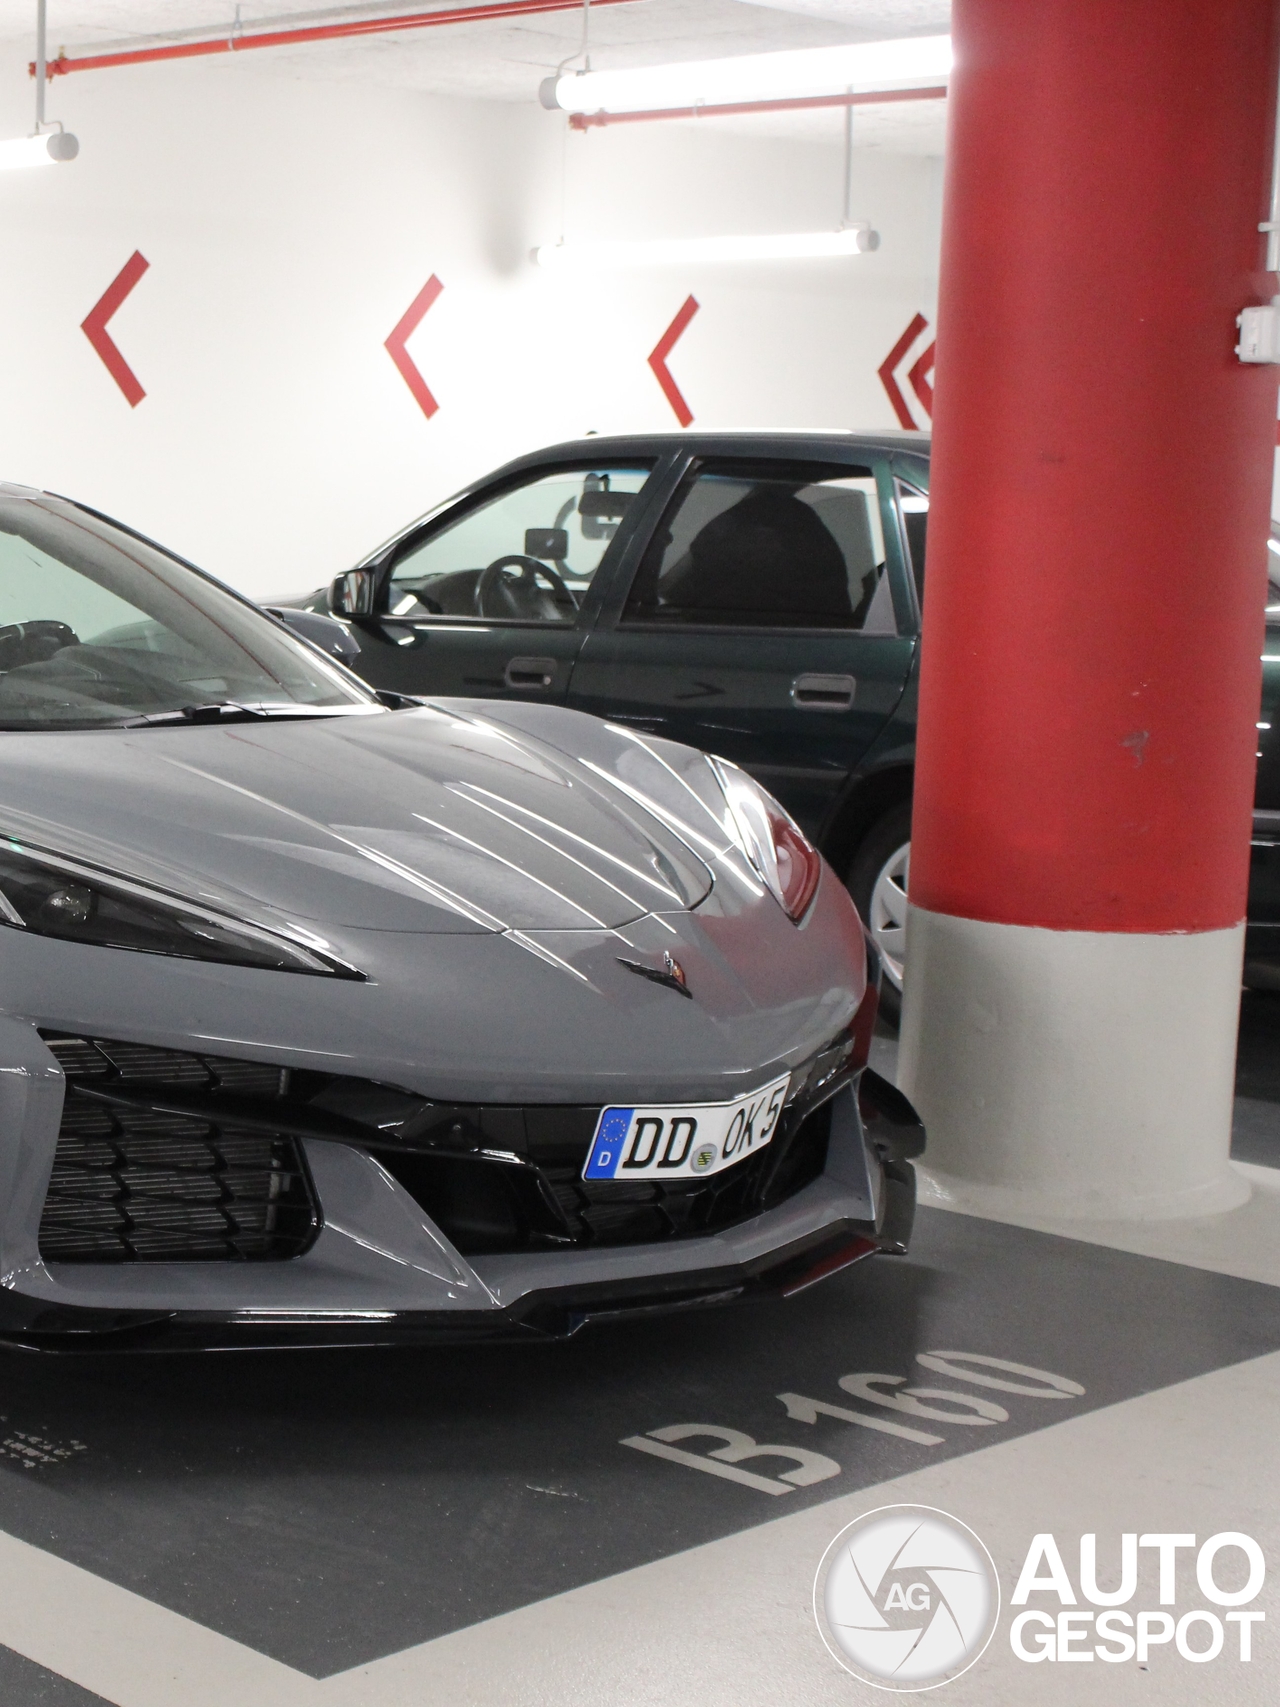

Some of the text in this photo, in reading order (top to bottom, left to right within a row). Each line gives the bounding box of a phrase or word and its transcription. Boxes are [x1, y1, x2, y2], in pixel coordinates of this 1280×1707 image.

[622, 1086, 786, 1169] DD OK 5
[597, 1151, 612, 1167] D
